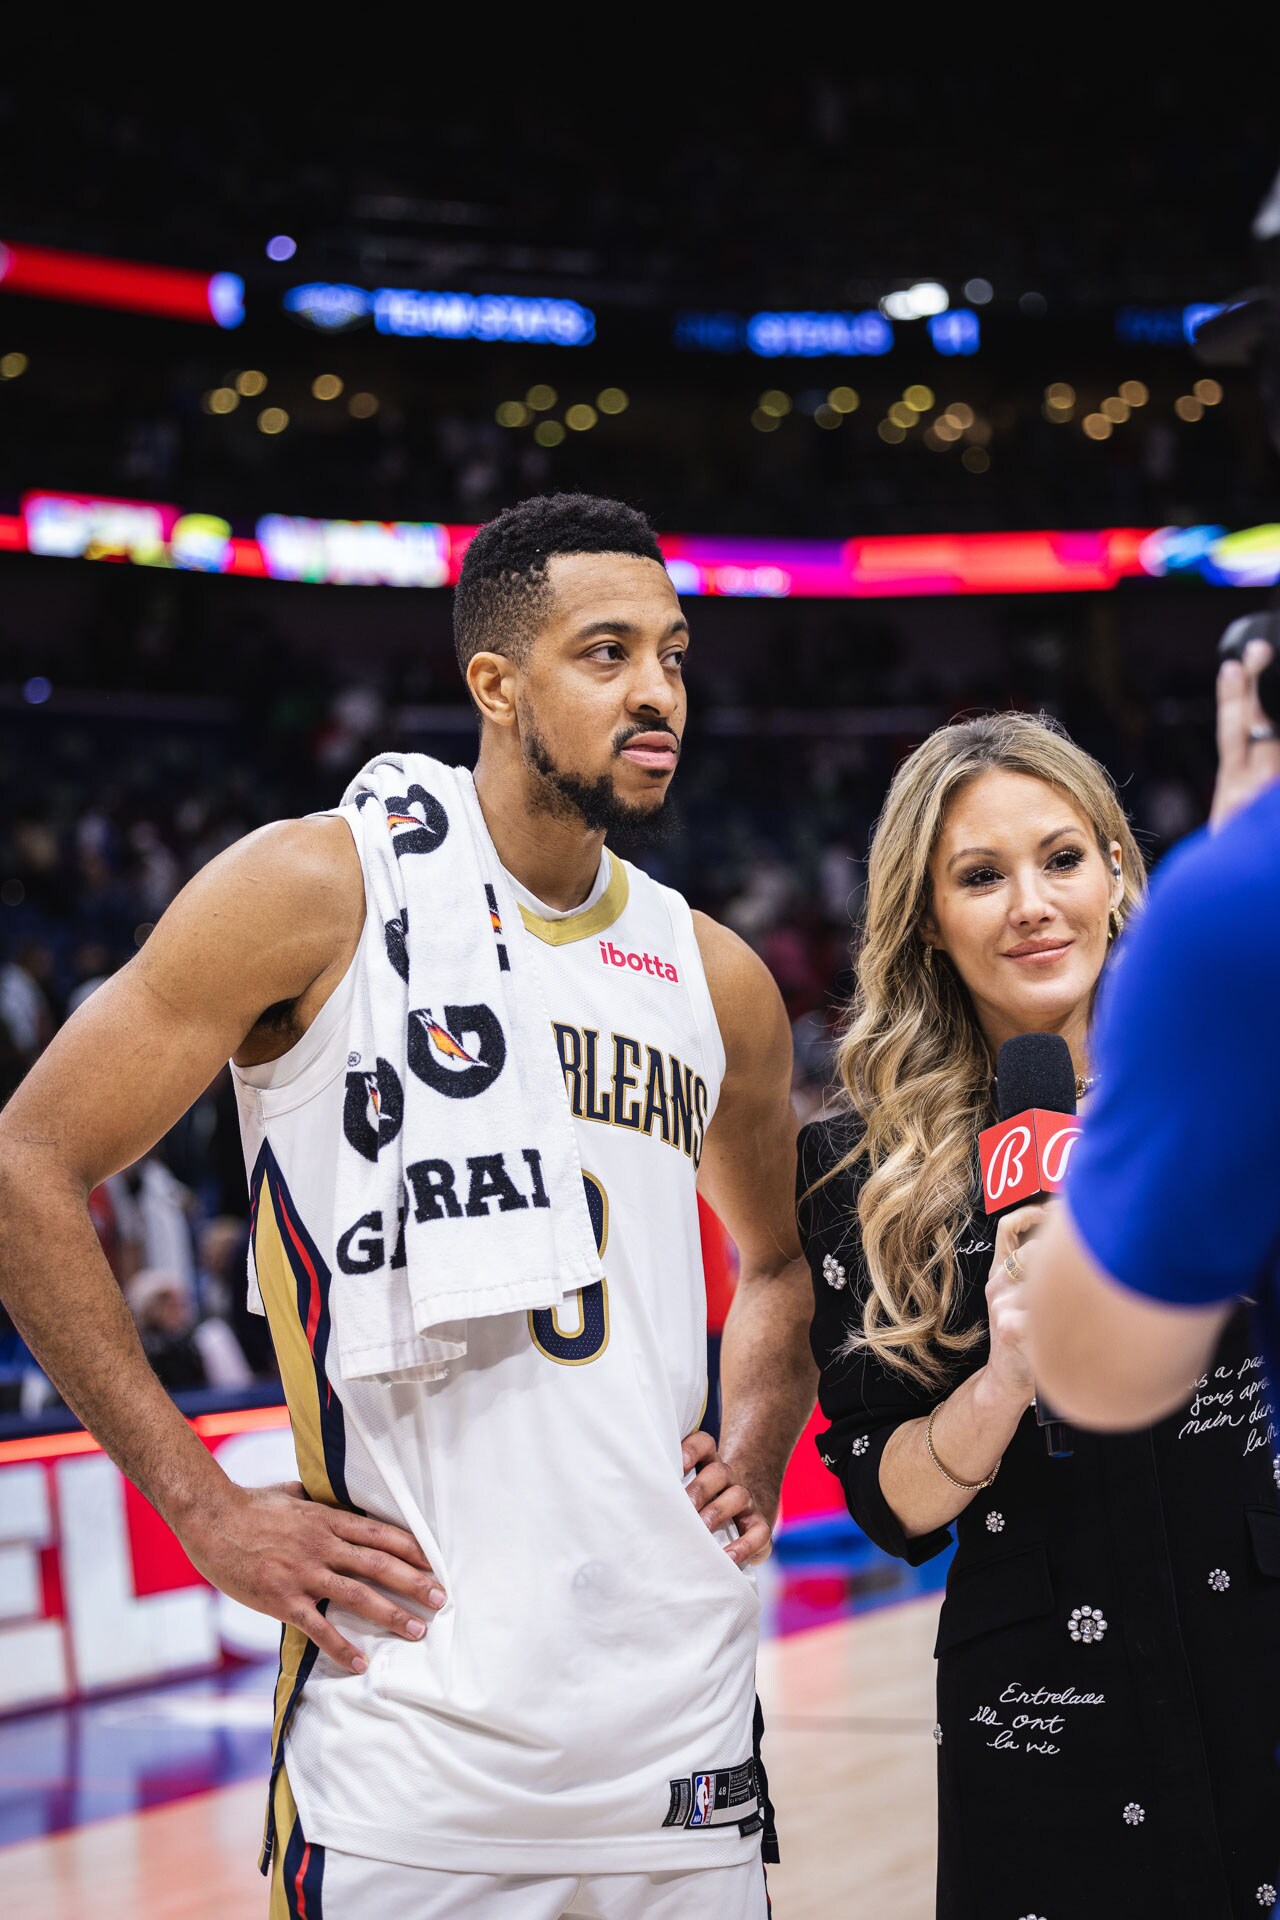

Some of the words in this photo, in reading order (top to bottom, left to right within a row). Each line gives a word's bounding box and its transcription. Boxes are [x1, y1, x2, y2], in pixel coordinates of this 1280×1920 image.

[599, 940, 679, 983] ibotta
[551, 1021, 708, 1172] RLEANS
[986, 1730, 1019, 1749] la
[1012, 1714, 1065, 1734] ont
